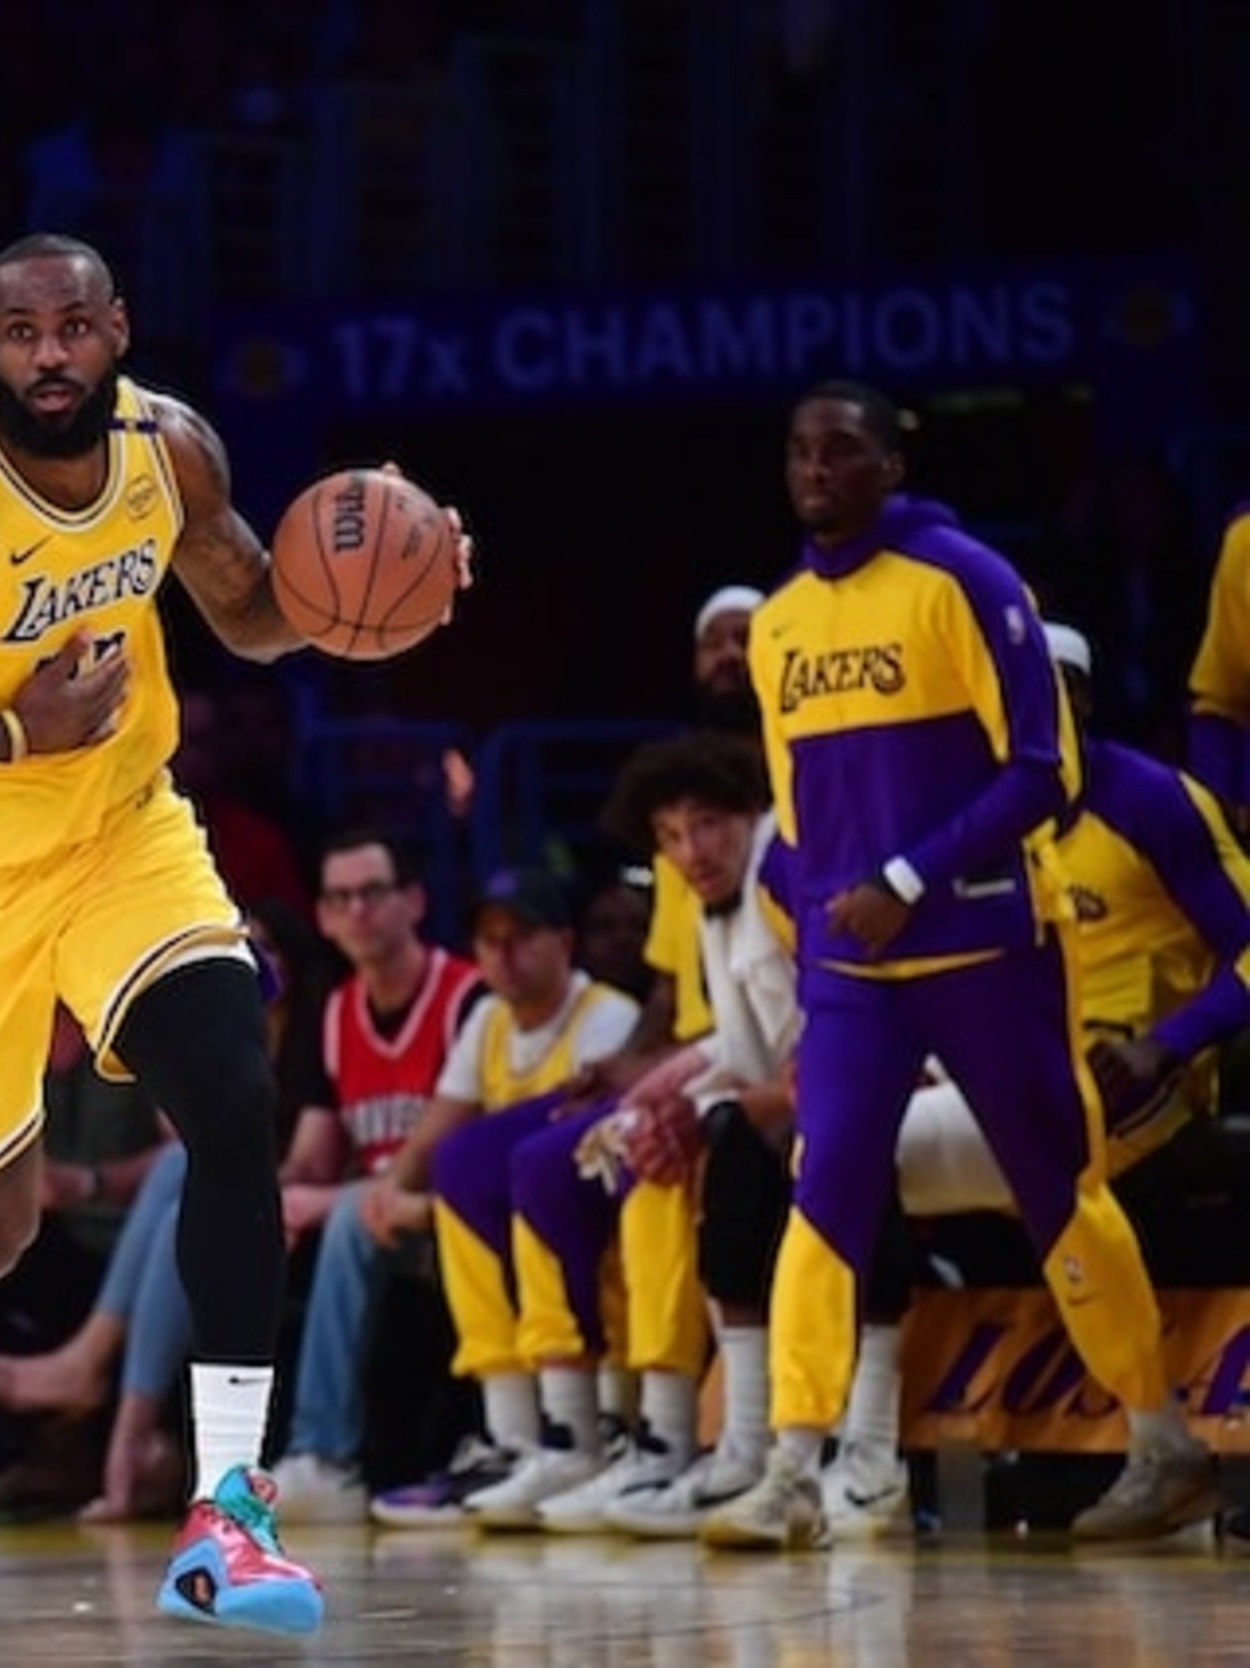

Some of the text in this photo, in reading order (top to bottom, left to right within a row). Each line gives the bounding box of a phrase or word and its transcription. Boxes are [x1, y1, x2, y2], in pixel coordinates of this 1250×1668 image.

[330, 280, 1077, 400] 17x CHAMPIONS
[779, 642, 905, 715] LAKERS
